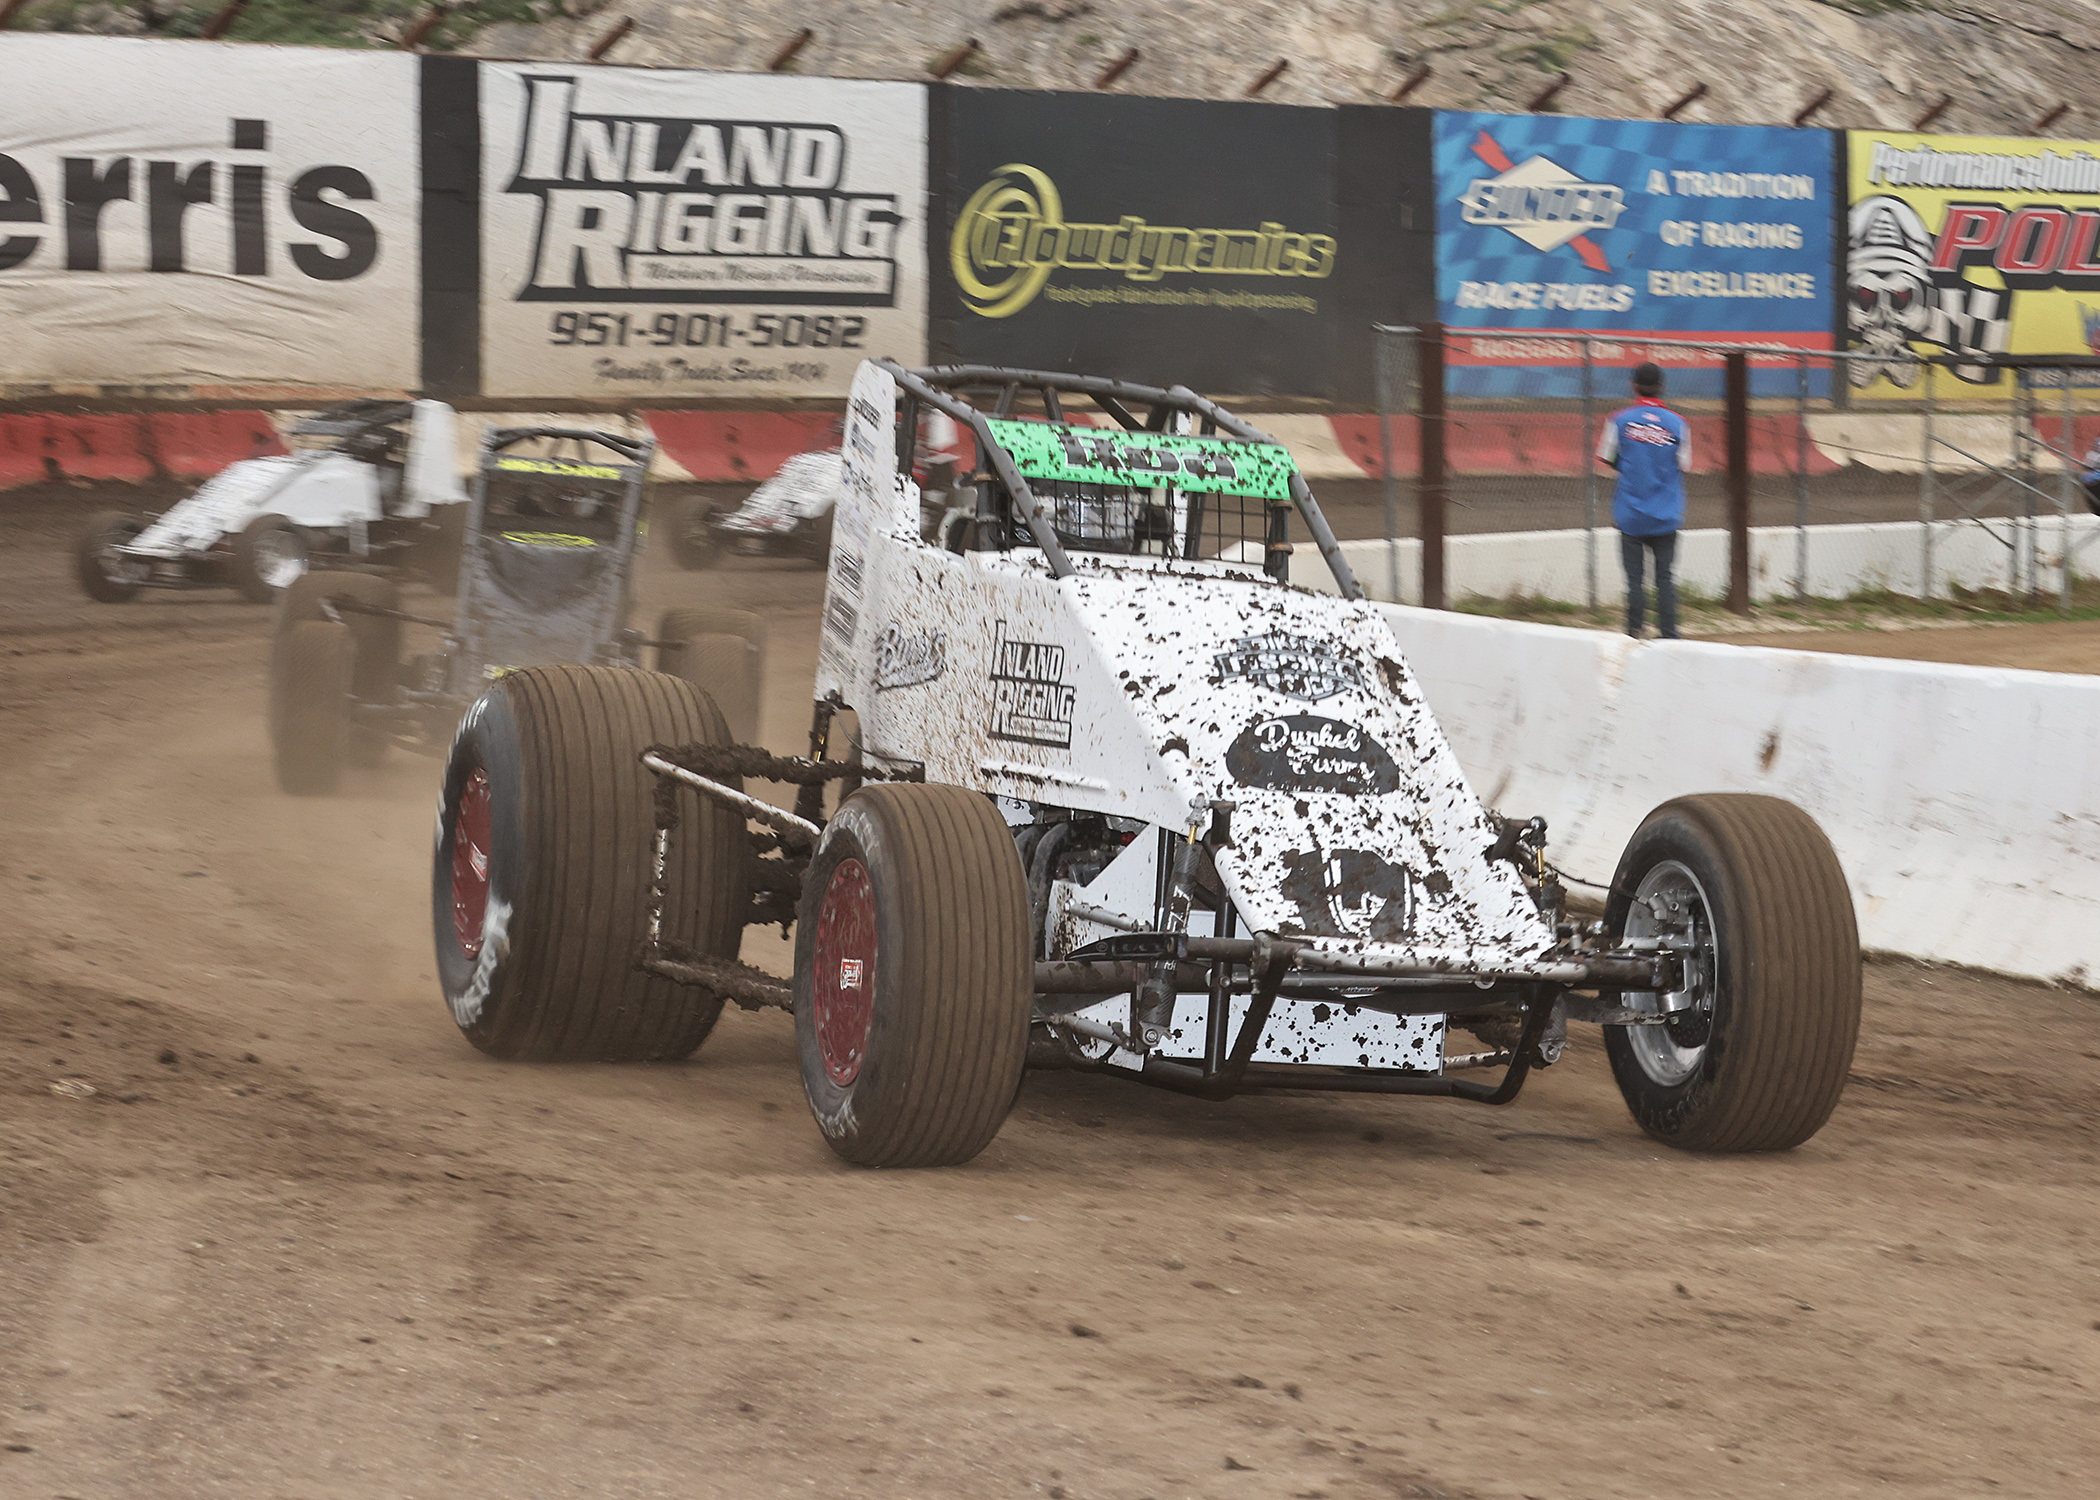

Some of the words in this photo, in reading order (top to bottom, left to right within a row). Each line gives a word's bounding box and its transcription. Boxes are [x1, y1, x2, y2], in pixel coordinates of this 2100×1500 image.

[508, 74, 848, 191] INLAND
[1645, 169, 1671, 196] A
[1670, 170, 1815, 200] TRADITION
[528, 185, 902, 292] RIGGING
[1659, 219, 1700, 247] OF
[1701, 221, 1804, 250] RACING
[1454, 280, 1543, 310] RACE
[1540, 282, 1636, 312] FUELS
[1647, 270, 1816, 299] EXCELLENCE
[549, 311, 869, 349] 951-901-5082
[990, 620, 1065, 683] INLAND
[989, 680, 1075, 738] RIGGING
